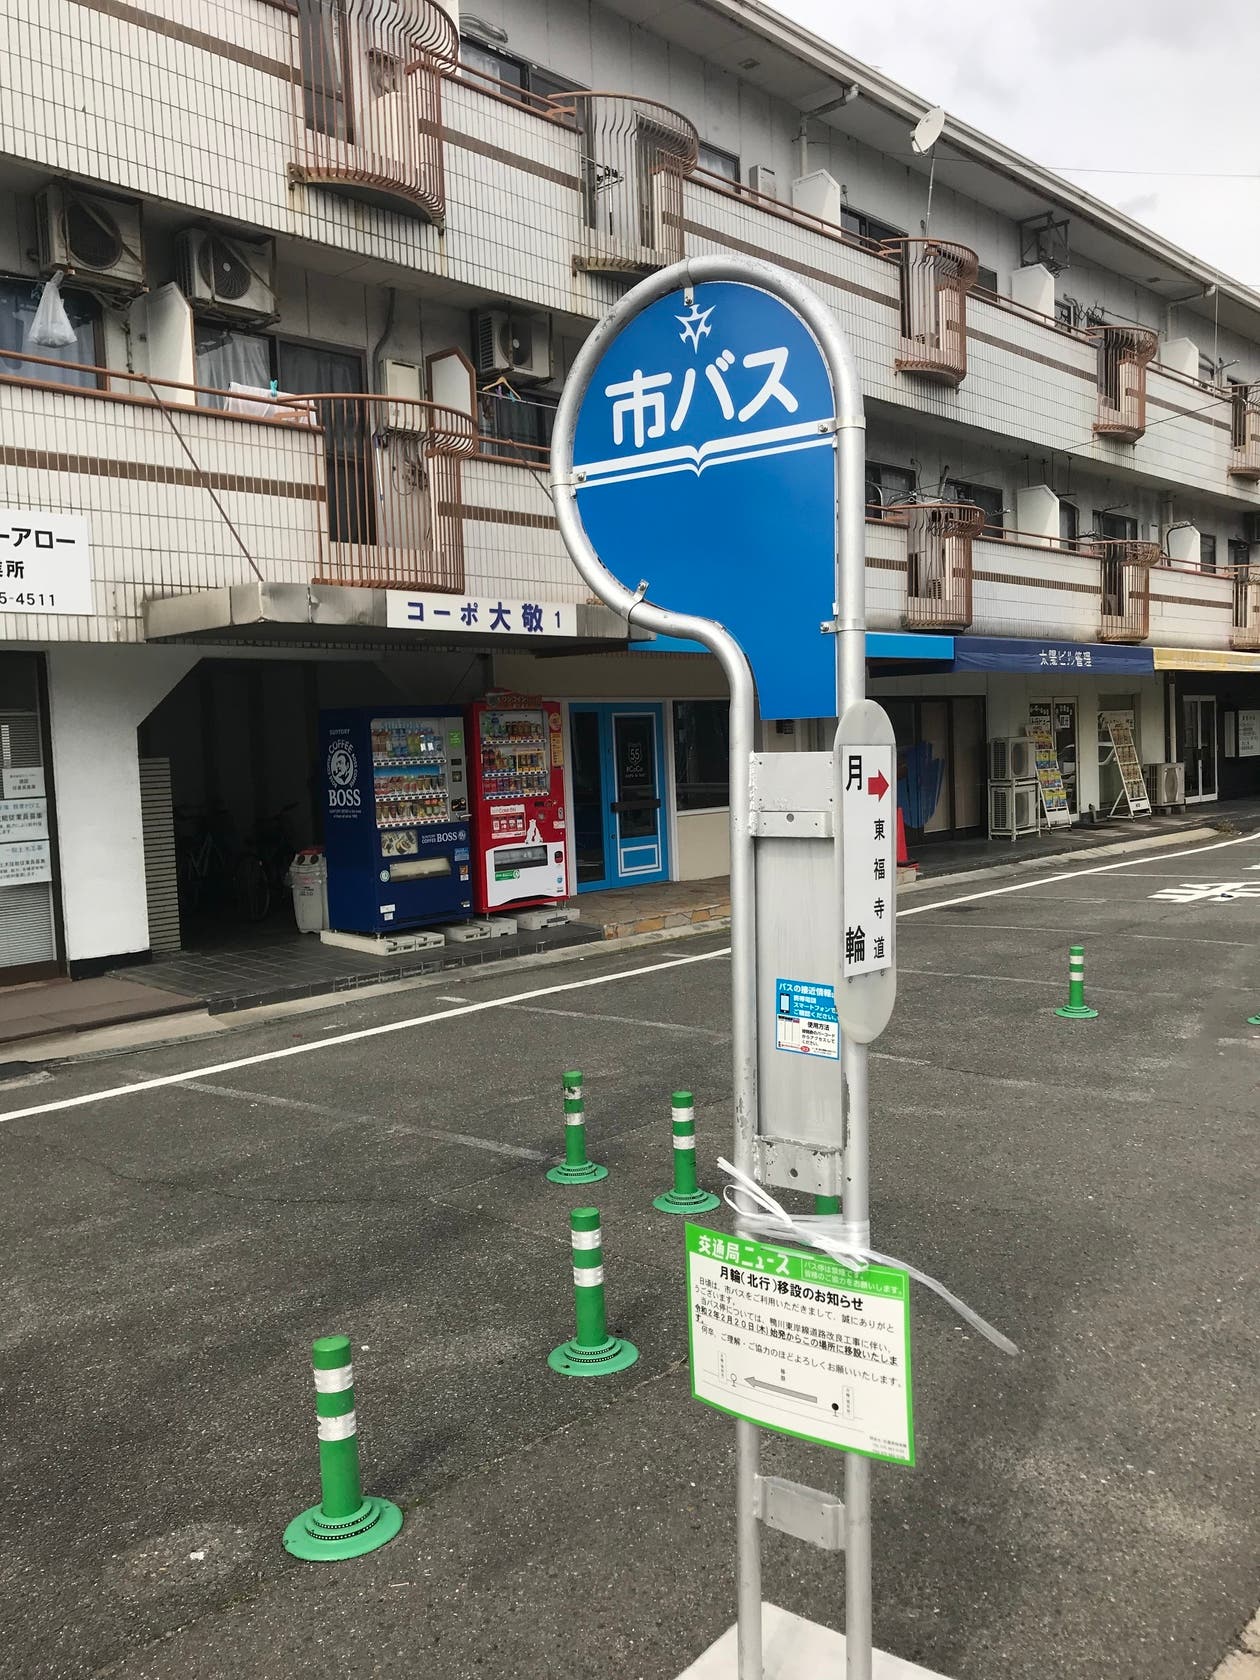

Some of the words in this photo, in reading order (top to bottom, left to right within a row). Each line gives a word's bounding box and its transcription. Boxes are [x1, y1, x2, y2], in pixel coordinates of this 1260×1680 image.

[605, 347, 798, 448] 市バス
[0, 560, 24, 579] 所
[328, 739, 354, 753] COFFEE
[328, 788, 361, 807] BOSS
[436, 831, 458, 843] BOSS
[873, 818, 885, 959] 東福寺道
[698, 1235, 790, 1275] 交通局ニュース
[720, 1265, 864, 1312] 月輪(北行)移設のお知らせ
